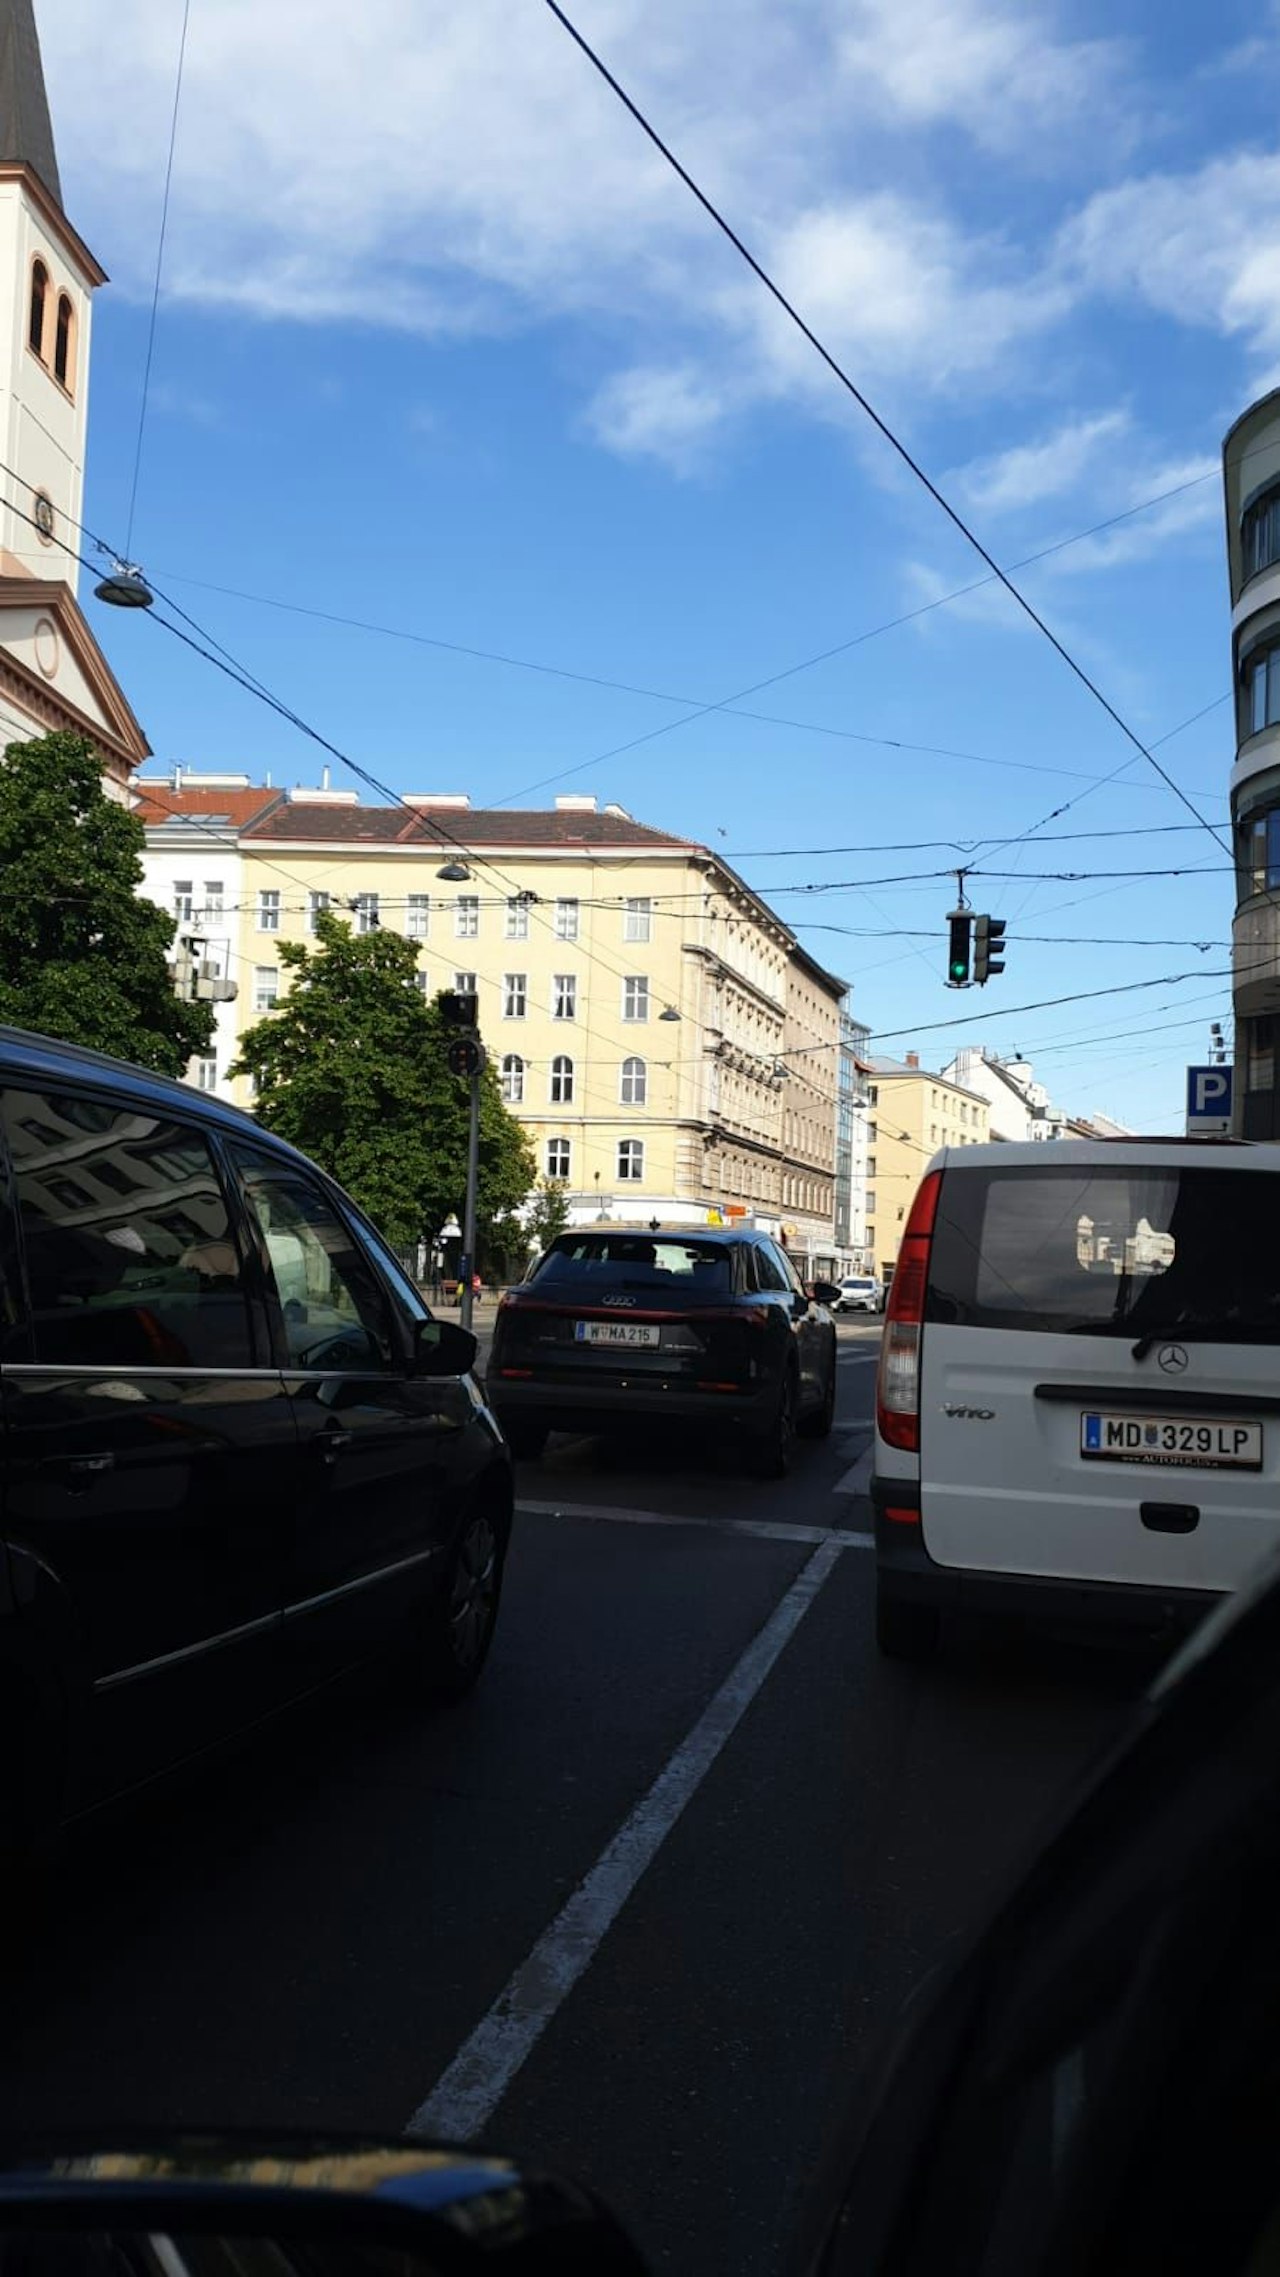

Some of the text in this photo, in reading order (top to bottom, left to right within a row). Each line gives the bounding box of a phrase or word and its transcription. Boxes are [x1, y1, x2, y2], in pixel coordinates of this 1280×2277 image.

[1195, 1073, 1228, 1111] P
[628, 1328, 651, 1341] 215
[1106, 1420, 1142, 1448] MD
